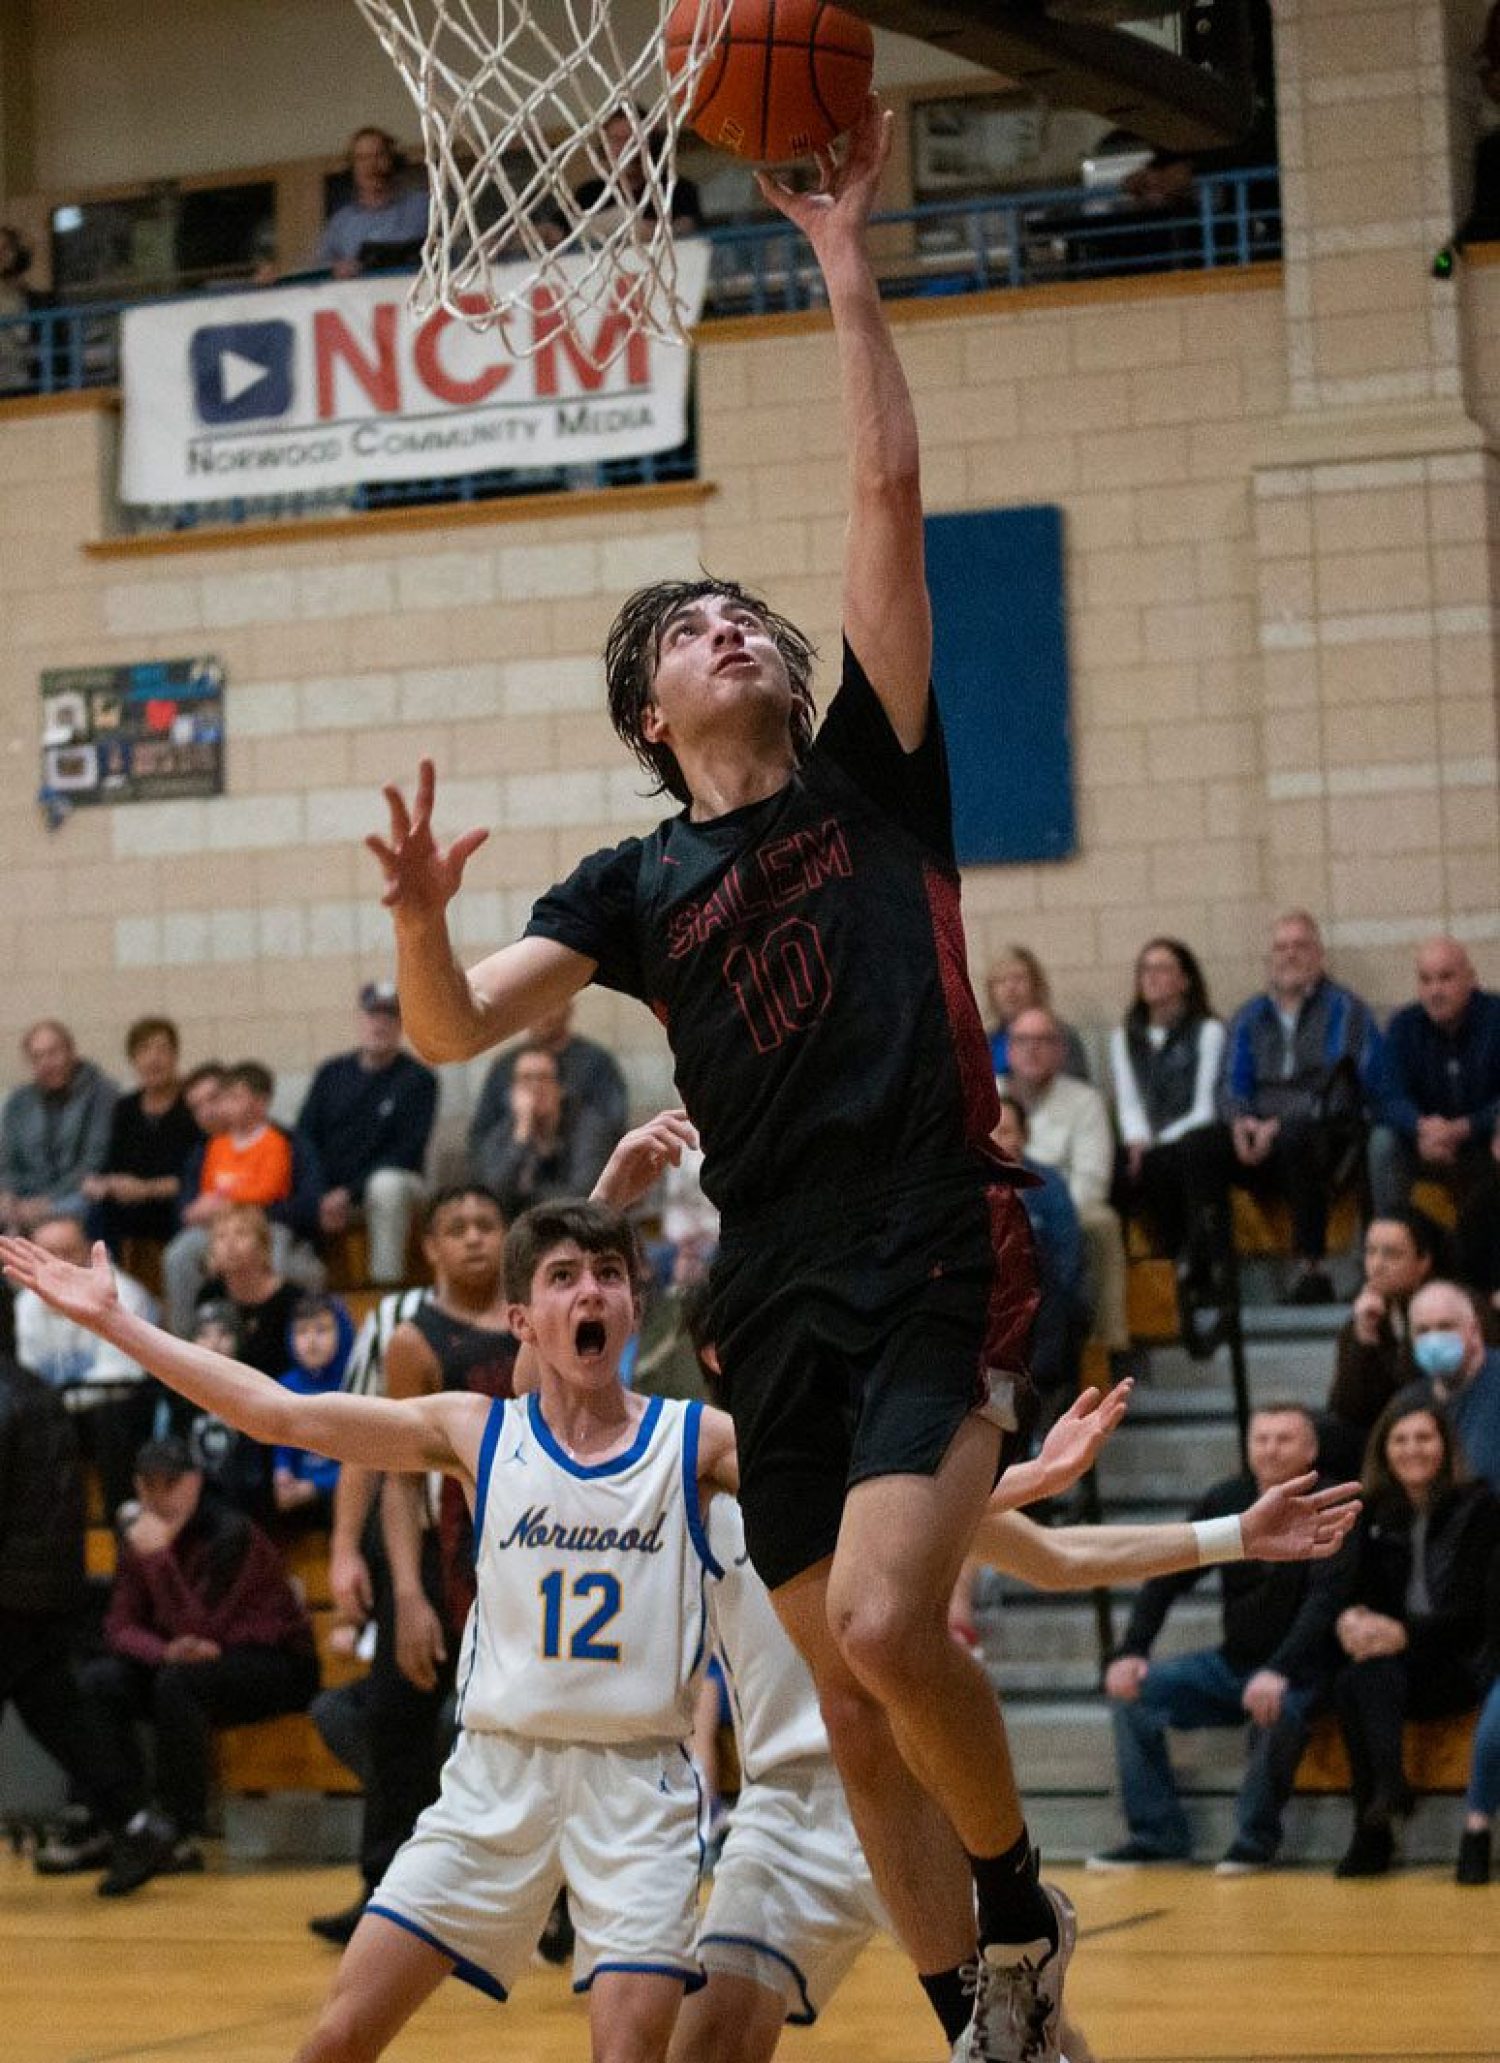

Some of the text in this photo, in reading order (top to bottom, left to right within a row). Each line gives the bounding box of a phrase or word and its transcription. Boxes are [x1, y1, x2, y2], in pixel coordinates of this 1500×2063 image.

[312, 273, 652, 421] NCM
[667, 817, 853, 960] SALEM
[722, 916, 833, 1053] 10
[499, 1504, 665, 1554] Norwood
[538, 1568, 624, 1662] 12
